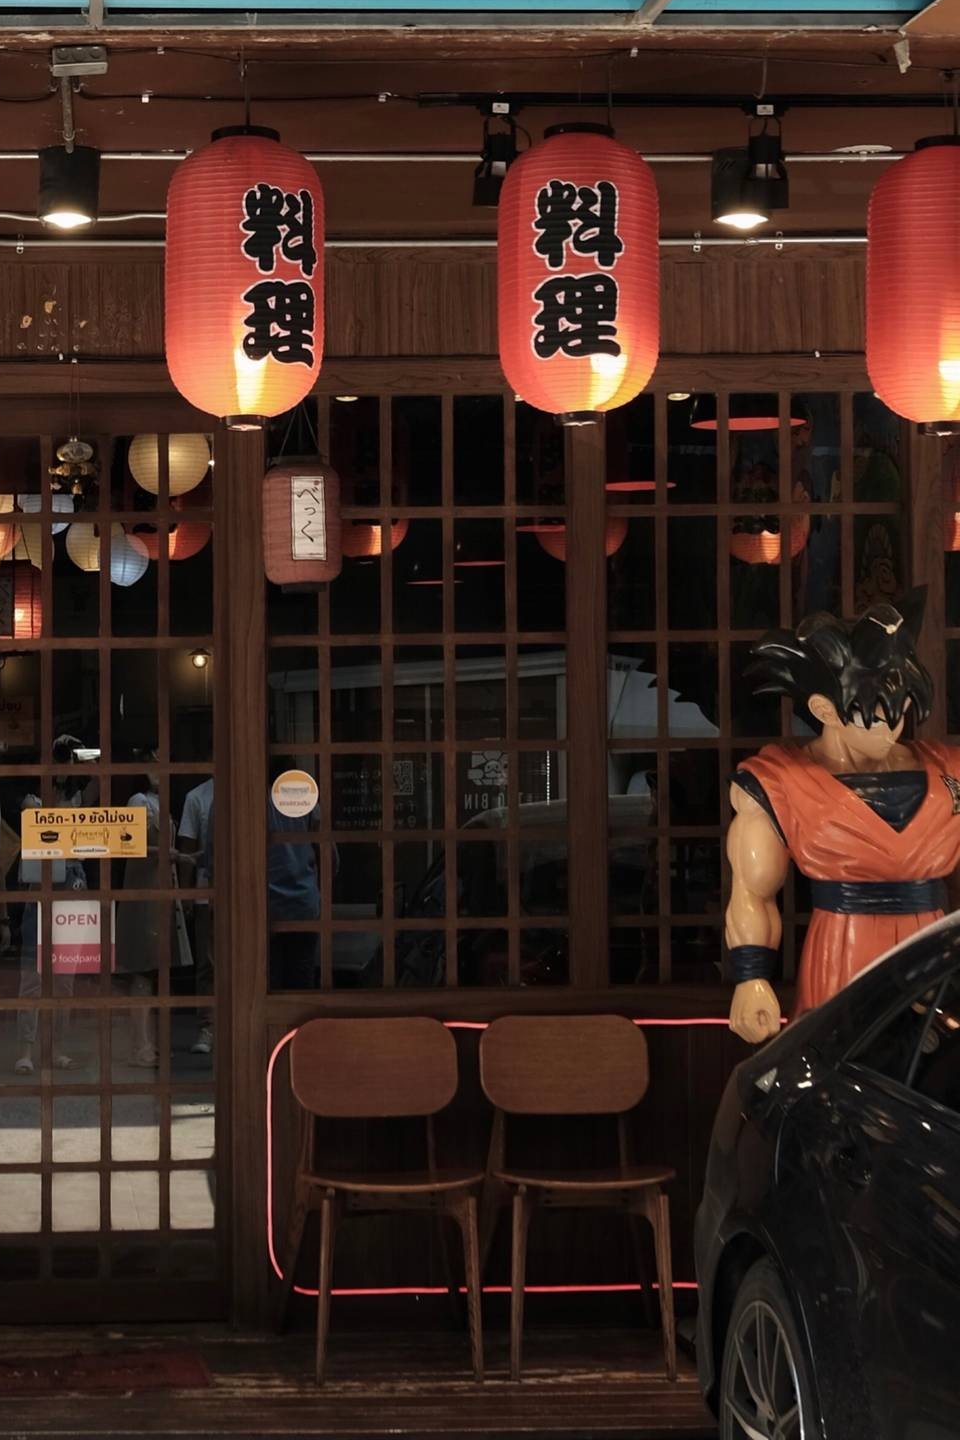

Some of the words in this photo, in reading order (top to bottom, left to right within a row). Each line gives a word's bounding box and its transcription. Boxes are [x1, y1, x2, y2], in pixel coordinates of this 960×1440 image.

[532, 179, 624, 359] 料理
[55, 913, 97, 926] OPEN
[58, 953, 101, 964] foodpand
